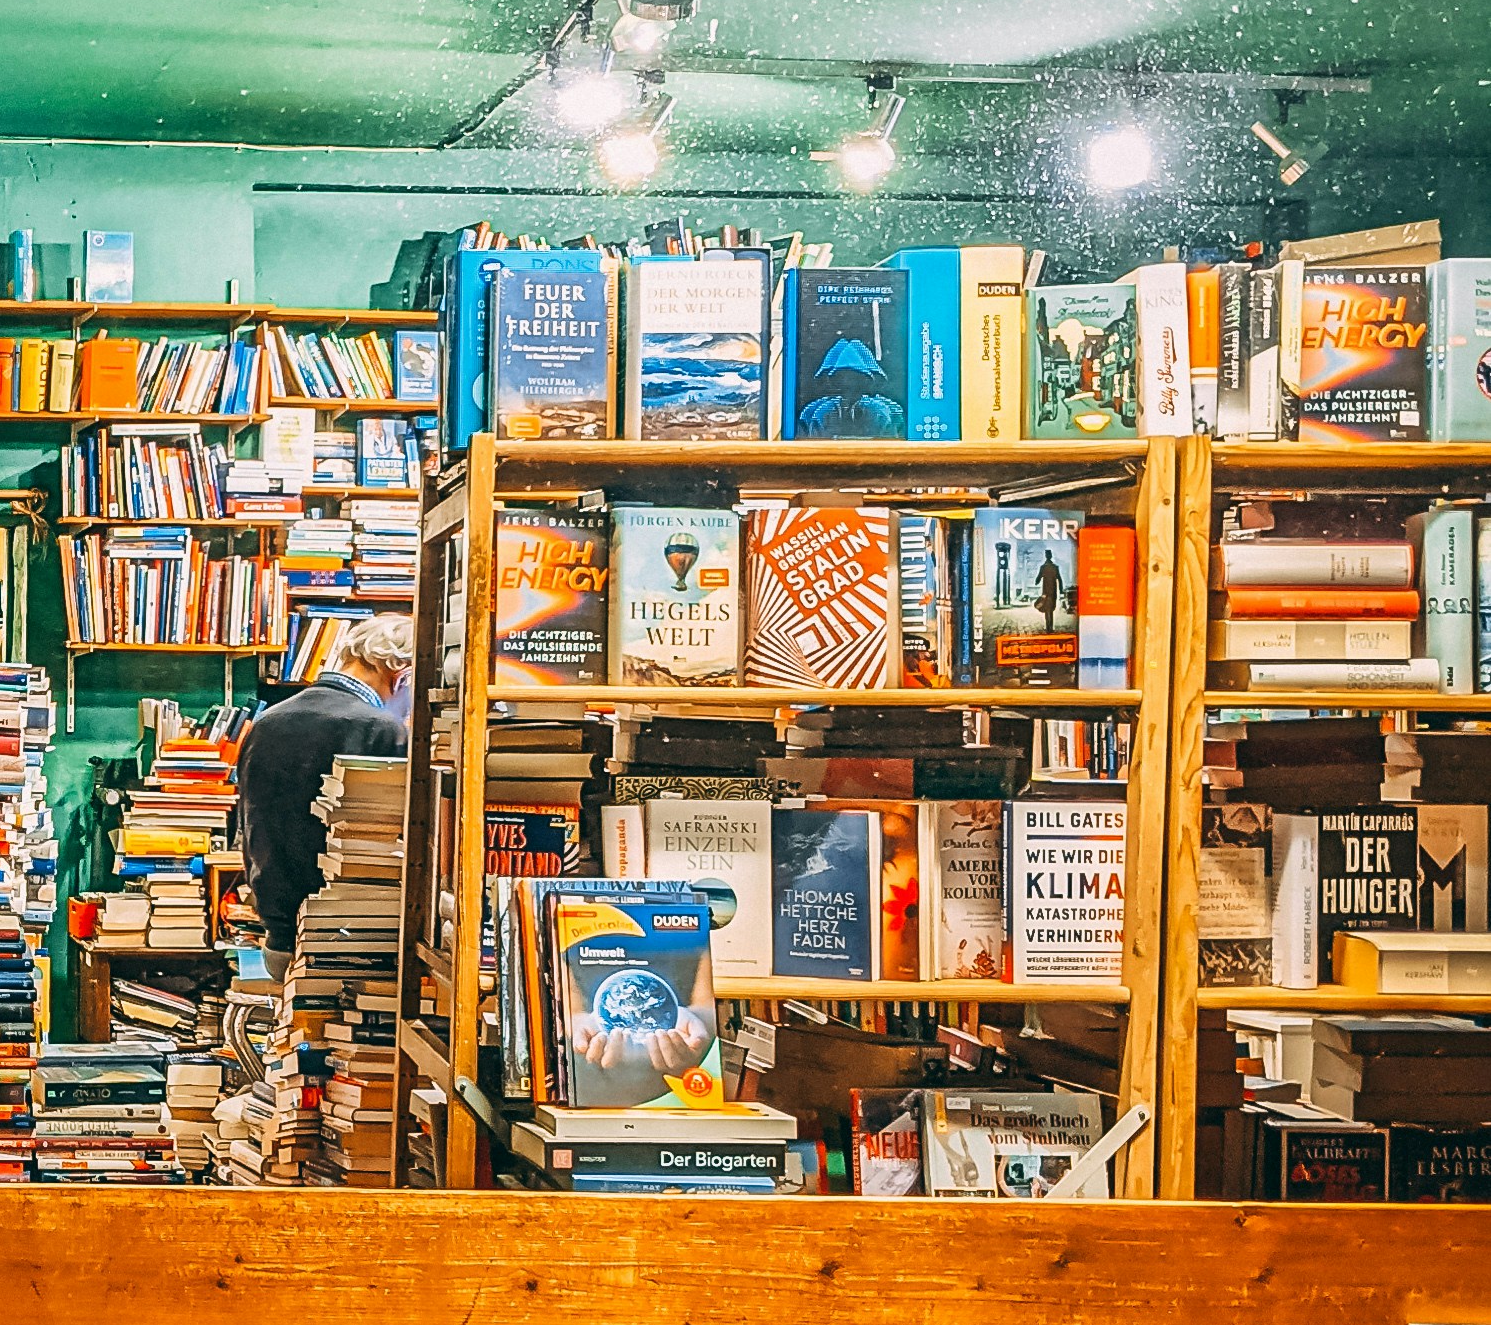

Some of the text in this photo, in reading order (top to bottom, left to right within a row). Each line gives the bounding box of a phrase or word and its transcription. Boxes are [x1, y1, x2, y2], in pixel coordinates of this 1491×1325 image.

[1304, 273, 1421, 285] JENS BALZER
[524, 284, 586, 301] FEUER
[647, 287, 757, 299] DER MORGEN
[978, 286, 1016, 295] DUDEN
[647, 303, 725, 314] DER WELT
[819, 296, 859, 304] PERFECT
[1145, 295, 1183, 308] KING
[534, 303, 575, 319] DER
[1322, 296, 1407, 322] HIGH
[507, 320, 600, 338] FREIHEIT
[982, 314, 990, 361] Deutsches
[1301, 322, 1427, 349] ENERGY
[993, 314, 1001, 411] Universalwörterbuch
[1156, 326, 1179, 416] Billy Summers
[528, 378, 575, 386] WOLFRAM
[1310, 390, 1331, 399] DIE
[1304, 401, 1418, 411] DAS PULSIERENDE
[1323, 413, 1398, 423] JAHRZEHNT
[503, 516, 604, 528] JENS BALZER
[630, 515, 733, 528] JÜRGEN KAUBE
[1004, 518, 1078, 540] KERR
[769, 521, 825, 560] WASSILI
[778, 521, 849, 571] GROSSMAN
[518, 540, 593, 565] HIGH
[786, 528, 871, 591] STALIN
[500, 566, 608, 591] ENERGY
[799, 561, 864, 609] GRAD
[630, 601, 731, 622] HEGELS
[509, 631, 528, 640] DIE
[646, 627, 715, 647] WELT
[973, 604, 983, 653] KERR
[503, 641, 603, 652] DAS PULSIERENDE
[1002, 643, 1074, 655] METROPOLIS
[520, 653, 586, 663] JAHRZEHNT
[663, 821, 758, 834] SAFRANSKI
[1026, 812, 1124, 829] BILL GATES
[1322, 813, 1414, 832] MARTÍN CAPARRÓS
[486, 824, 527, 849] YVES
[664, 836, 757, 853] EINZELN
[618, 818, 626, 878] ropaganda
[1026, 848, 1123, 864] WIE WIR DIE
[1345, 837, 1391, 873] DER
[486, 851, 562, 877] ONTAND
[686, 855, 733, 871] SEIN
[968, 873, 999, 885] VOR
[1026, 872, 1124, 900] KLIMA
[784, 889, 855, 906] THOMAS
[1322, 878, 1413, 918] HUNGER
[780, 903, 858, 921] HETTCHE
[1026, 907, 1123, 921] KATASTROPHE
[653, 915, 699, 927] DUDEN
[798, 919, 840, 934] HERZ
[793, 933, 846, 950] FADEN
[1026, 928, 1123, 943] VERHINDERN
[579, 946, 626, 958] Umwelt
[1303, 926, 1311, 965] ROBERT
[970, 1113, 1089, 1129] Das große Buch
[987, 1133, 1018, 1145] vom
[660, 1150, 777, 1172] Der Biogarten
